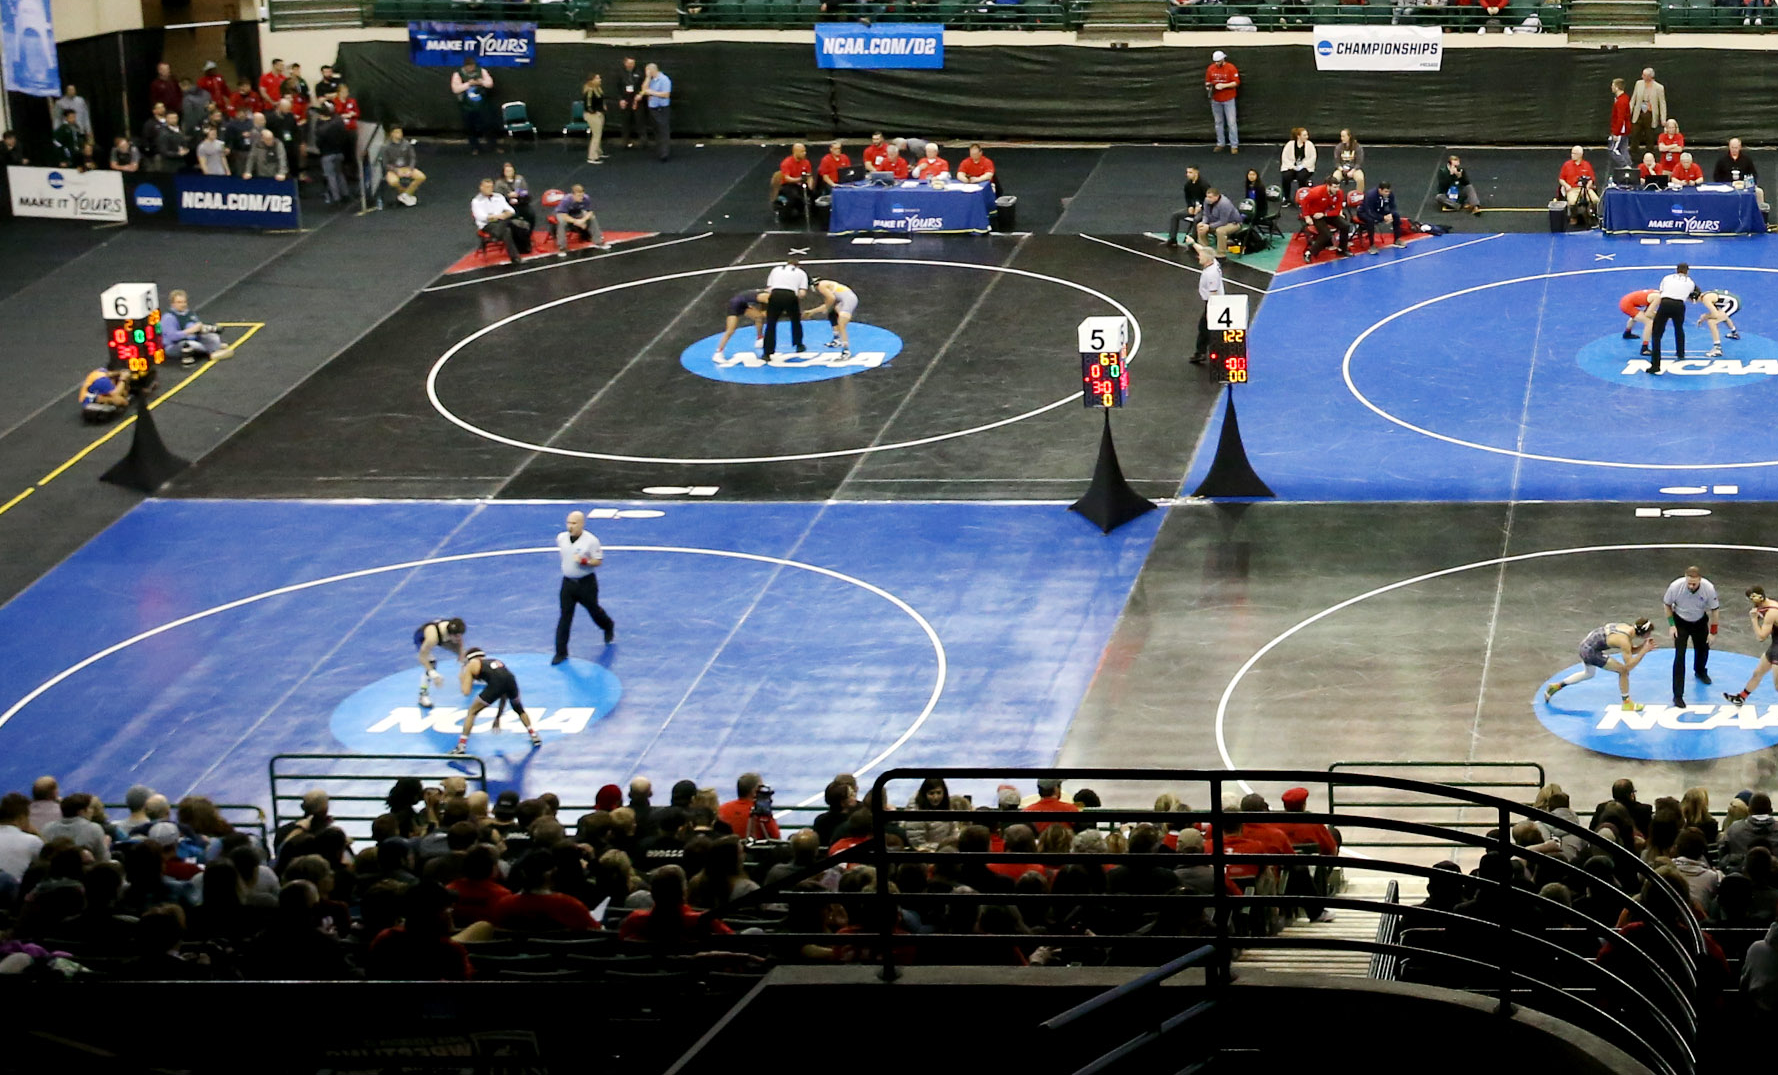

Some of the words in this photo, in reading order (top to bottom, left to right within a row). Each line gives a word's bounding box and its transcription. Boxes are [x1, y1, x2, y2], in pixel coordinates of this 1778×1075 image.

[426, 38, 462, 51] MAKE
[464, 38, 476, 51] IT
[477, 34, 528, 56] YOURS
[822, 36, 937, 56] NCAA.COM/D2
[1336, 41, 1439, 57] CHAMPIONSHIPS
[19, 195, 53, 208] MAKE
[70, 192, 123, 215] YOURS
[181, 190, 293, 213] NCAA.COM/D2
[873, 218, 896, 228] MAKE
[906, 214, 943, 231] YOURS
[1648, 219, 1673, 229] MAKE
[1684, 215, 1720, 232] YOURS
[115, 296, 129, 316] 6
[1217, 307, 1233, 327] 4
[115, 328, 127, 344] 0
[133, 329, 145, 344] 0
[1091, 329, 1105, 350] 5
[1223, 330, 1243, 343] 122
[1100, 353, 1118, 366] 63
[1090, 365, 1101, 378] 0
[1110, 365, 1120, 378] 0
[1103, 394, 1113, 407] 0
[367, 706, 596, 734] NCAA
